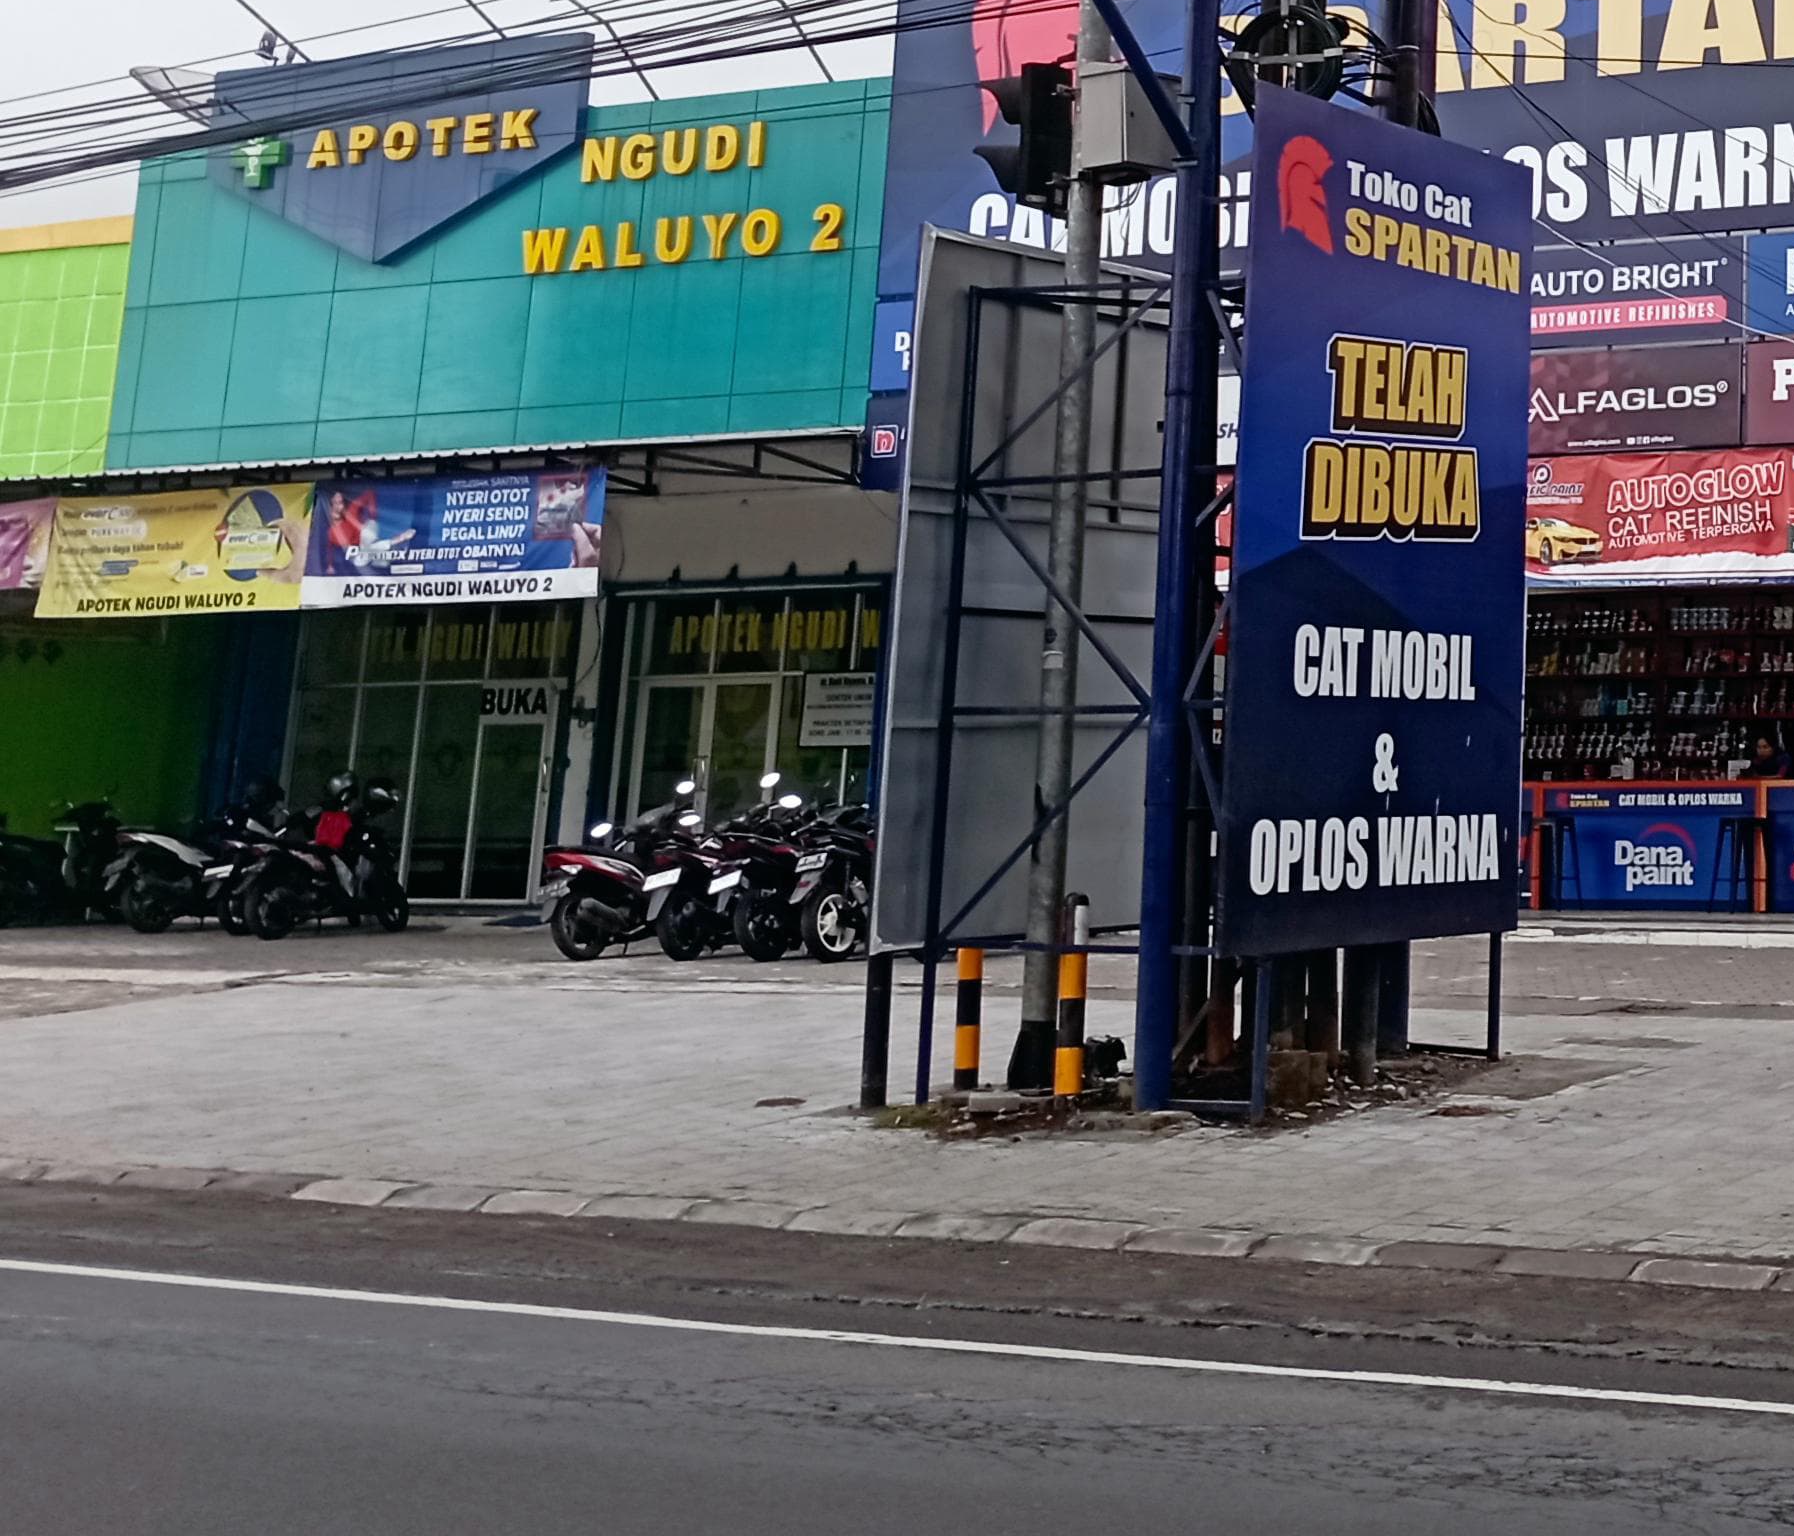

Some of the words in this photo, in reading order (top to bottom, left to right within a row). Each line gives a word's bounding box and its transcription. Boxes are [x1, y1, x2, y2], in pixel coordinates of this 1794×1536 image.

[306, 107, 539, 170] APOTEK
[580, 119, 767, 183] NGUDI
[1346, 161, 1419, 214] Toko
[1424, 183, 1473, 229] Cat
[521, 207, 781, 275] WALUYO
[808, 202, 846, 252] 2
[969, 192, 1068, 255] CA
[1344, 208, 1522, 295] SPARTAN
[1530, 268, 1604, 298] AUTO
[1613, 260, 1717, 292] BRIGHT
[1628, 301, 1716, 324] REFINISHES
[1334, 338, 1467, 432] TELAH
[446, 490, 488, 506] NYERI
[490, 488, 531, 504] OTOT
[1307, 443, 1478, 532] DIBUKA
[1606, 460, 1786, 514] AUTOGLOW
[441, 527, 486, 542] PEGAL
[486, 524, 526, 539] LINU?
[442, 508, 485, 524] NYERI
[485, 506, 530, 522] SENDI
[1608, 514, 1653, 538] CAT
[1665, 500, 1773, 531] REFINISH
[1608, 530, 1687, 549] AUTOMOTIVE
[1691, 520, 1775, 541] TERPERCAYA
[76, 597, 132, 614] APOTEK
[135, 595, 181, 612] NGUDI
[184, 592, 244, 609] WALUYO
[247, 592, 257, 606] 2
[343, 583, 406, 599] APOTEK
[411, 581, 463, 597] NGUDI
[467, 578, 539, 594] WALUYO
[542, 577, 554, 592] 2
[1293, 624, 1365, 697] CAT
[1370, 629, 1476, 701] MOBIL
[479, 686, 548, 716] BUKA
[1372, 732, 1399, 793] &
[1618, 793, 1635, 806] CAT
[1637, 793, 1666, 806] MOBIL
[1667, 792, 1677, 806] &
[1678, 793, 1707, 806] OPLOS
[1708, 792, 1743, 806] WARNA
[1250, 816, 1370, 896] OPLOS
[1378, 813, 1500, 887] WARNA
[1614, 839, 1684, 866] Dana
[1625, 860, 1694, 892] paint
